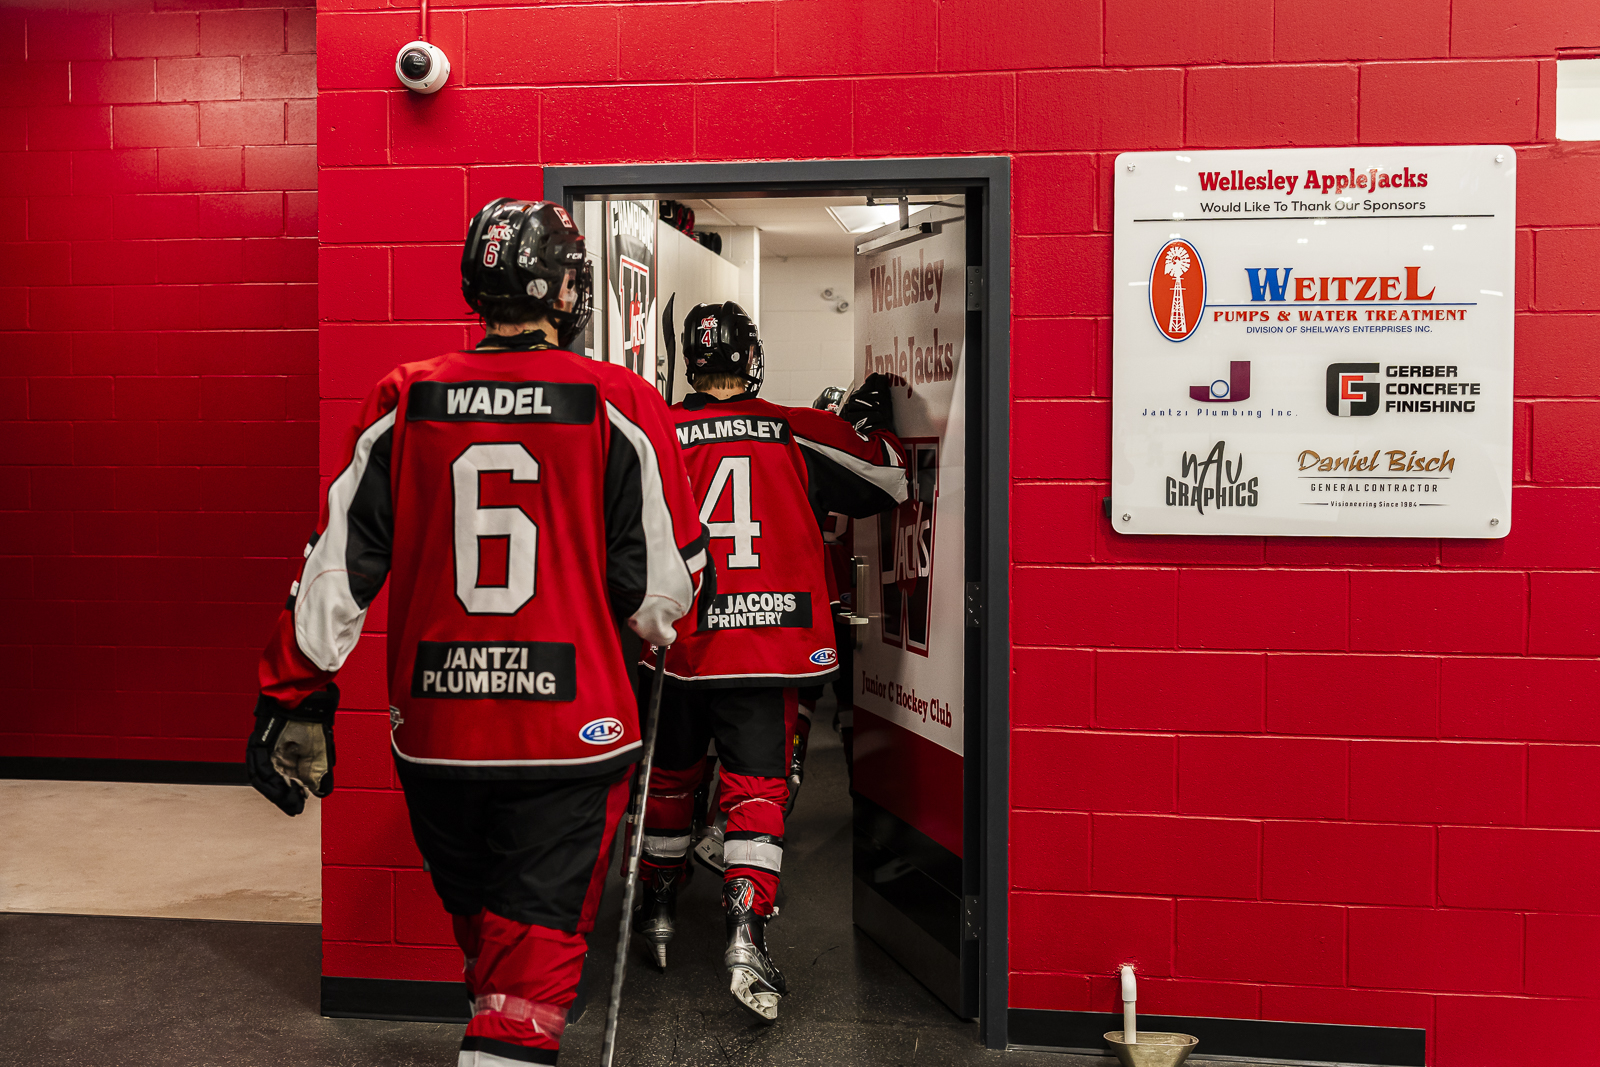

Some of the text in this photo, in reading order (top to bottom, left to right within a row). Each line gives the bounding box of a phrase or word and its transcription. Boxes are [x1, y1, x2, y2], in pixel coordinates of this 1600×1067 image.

[1198, 167, 1428, 195] Wellesley AppleJacks
[1200, 200, 1427, 213] Would Like To Thank Our Sponsors
[483, 241, 500, 268] 6
[870, 248, 944, 313] Wellesley
[1244, 266, 1436, 302] WEITZEL
[1213, 309, 1467, 322] PUMPS & WATER TREATMENT
[701, 330, 711, 347] 4
[1246, 326, 1284, 334] DIVISION
[1352, 325, 1413, 333] ENTERPRISES
[1415, 325, 1433, 333] INC.
[864, 328, 954, 399] ApleJacks
[1386, 365, 1458, 378] GERBER
[1386, 383, 1481, 395] CONCRETE
[447, 387, 552, 416] WADEL
[1142, 408, 1298, 418] Jantzi Plumbing Inc.
[1386, 400, 1476, 413] FINISHING
[1297, 450, 1456, 473] Daniel Bisch
[1165, 476, 1258, 506] GRAPHICS
[1310, 483, 1438, 492] GENERAL CONTRACTOR
[699, 456, 762, 570] 4
[452, 441, 541, 616] 6
[725, 593, 797, 614] JACOBS
[707, 612, 782, 629] PRINTERY
[443, 647, 529, 670] JANTZI
[422, 670, 556, 695] PLUMBING
[862, 670, 952, 728] Junior C Hockey Club
